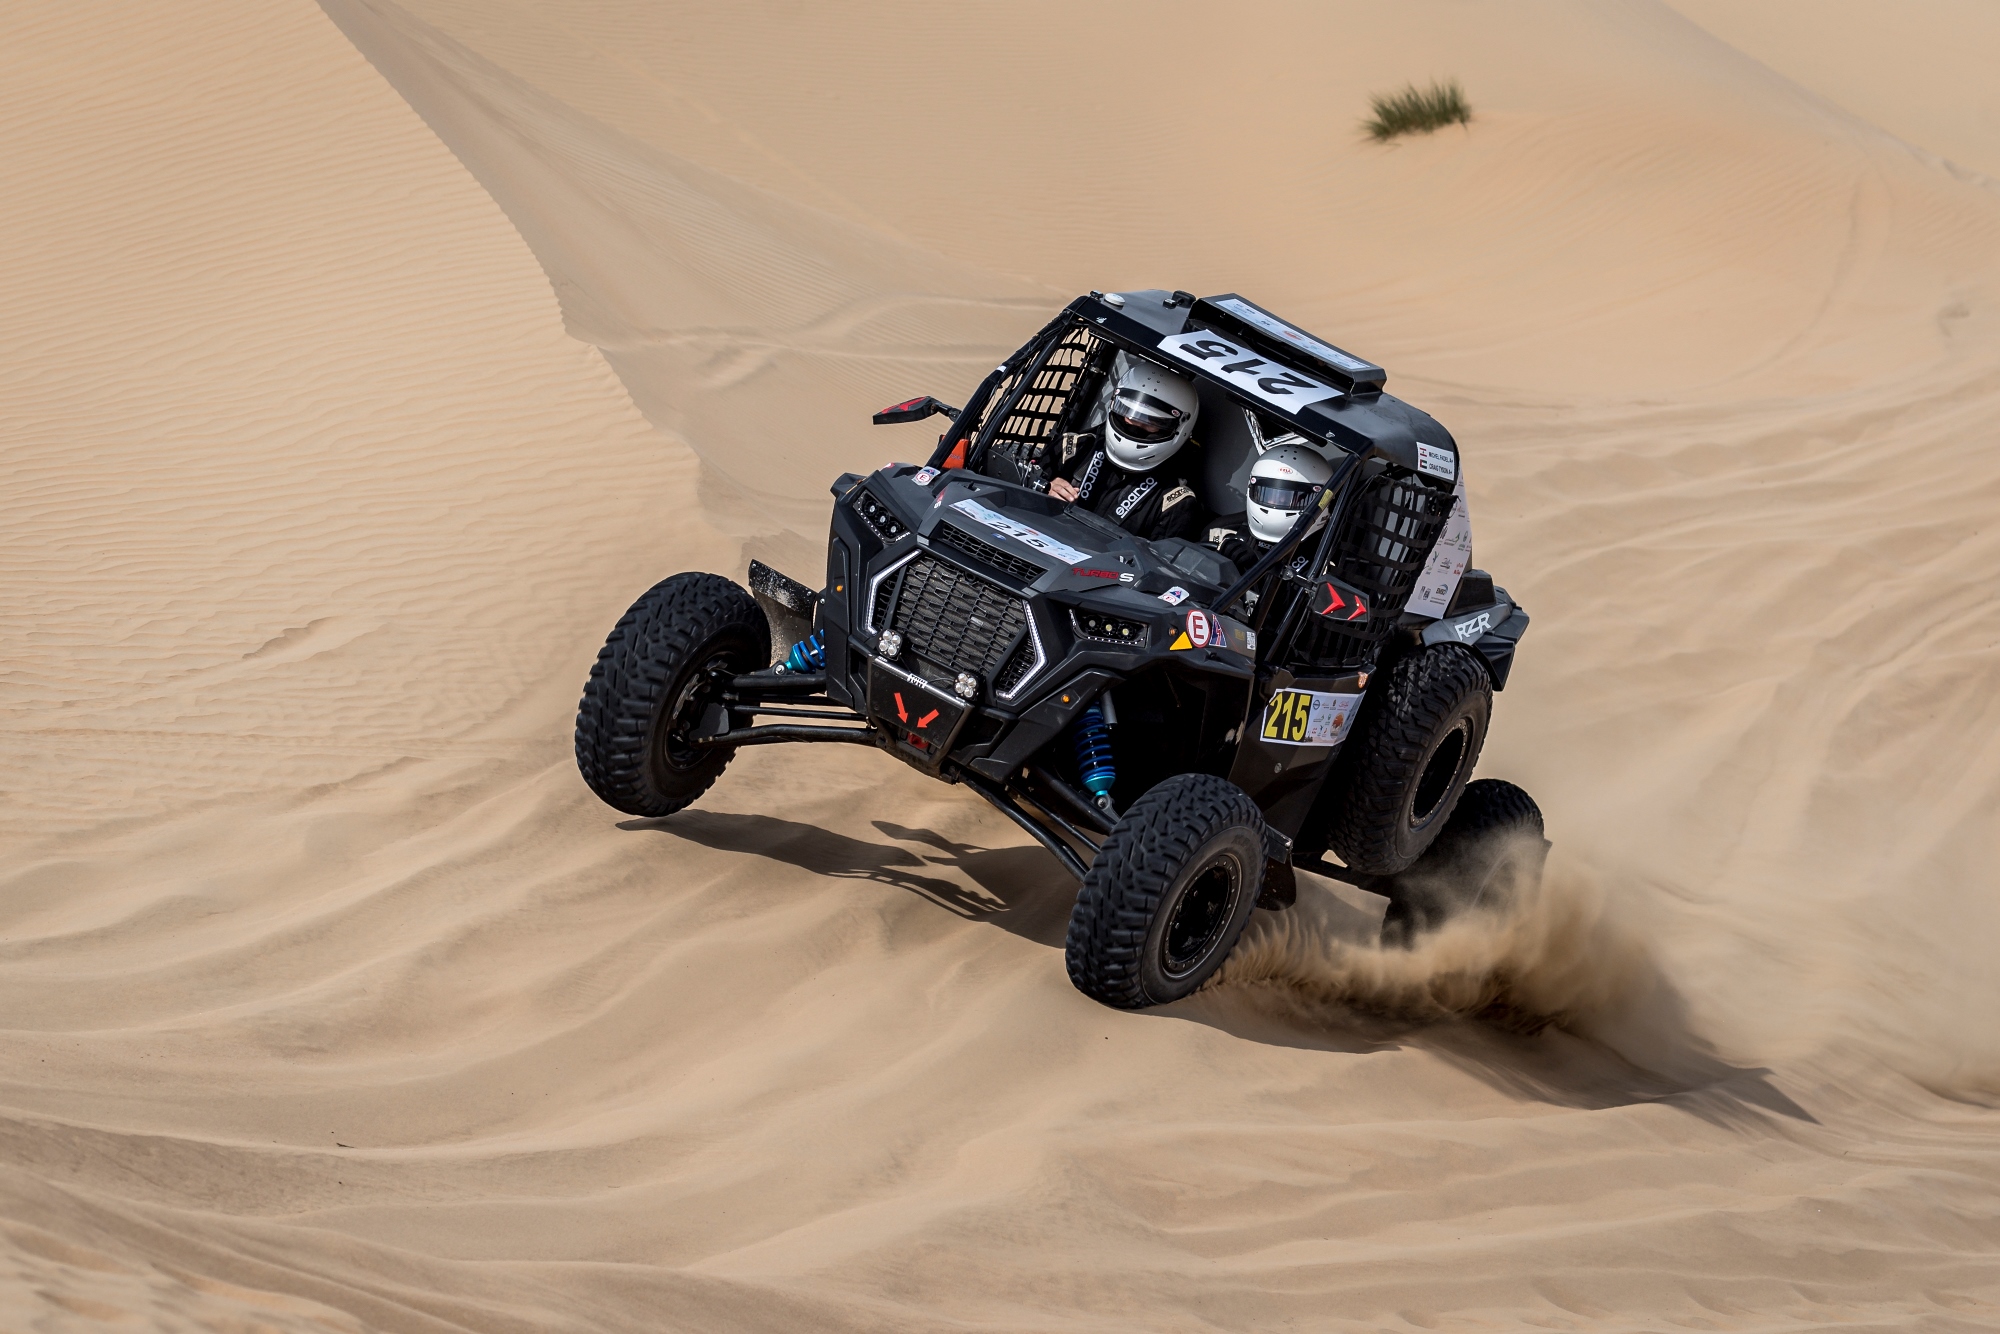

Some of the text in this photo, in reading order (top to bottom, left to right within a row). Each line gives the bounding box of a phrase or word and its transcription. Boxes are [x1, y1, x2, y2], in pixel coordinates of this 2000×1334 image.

[1178, 340, 1319, 395] 215
[1080, 451, 1105, 499] sparco
[1115, 477, 1155, 516] sparco
[988, 521, 1049, 549] 215
[1071, 567, 1135, 583] TURBO S
[1193, 615, 1205, 639] E
[1455, 612, 1492, 641] RZR
[1264, 692, 1311, 741] 215
